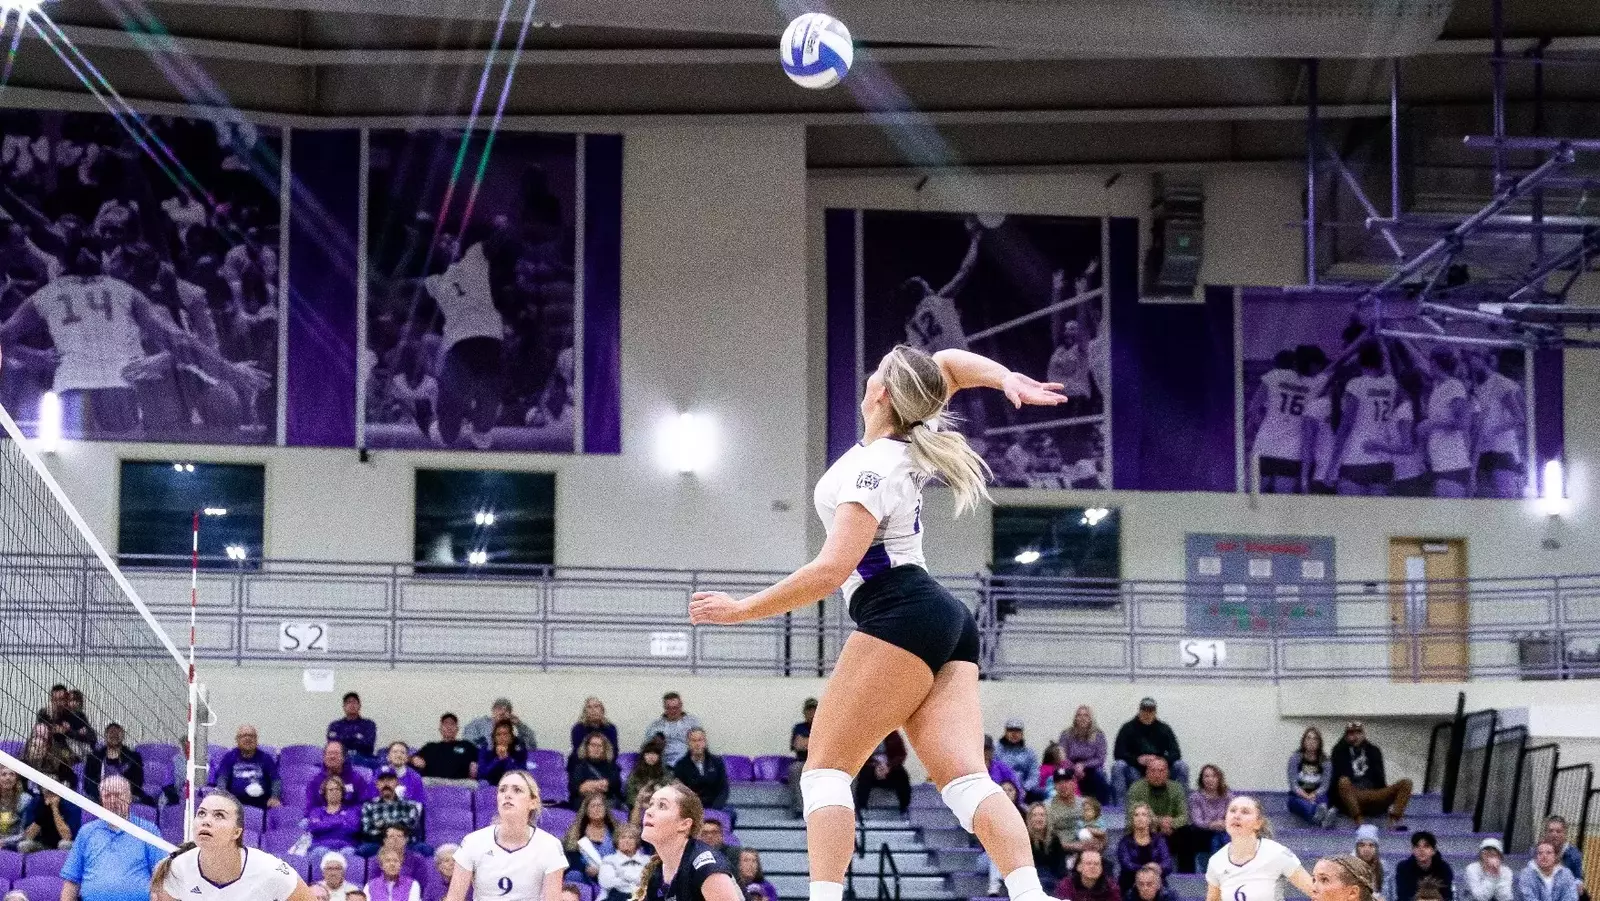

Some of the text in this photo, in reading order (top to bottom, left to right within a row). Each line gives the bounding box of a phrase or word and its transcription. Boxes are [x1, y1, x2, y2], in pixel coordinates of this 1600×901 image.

[58, 290, 113, 326] 14
[911, 310, 944, 346] 12
[1280, 392, 1305, 416] 16
[1374, 400, 1391, 422] 12
[498, 876, 513, 897] 9
